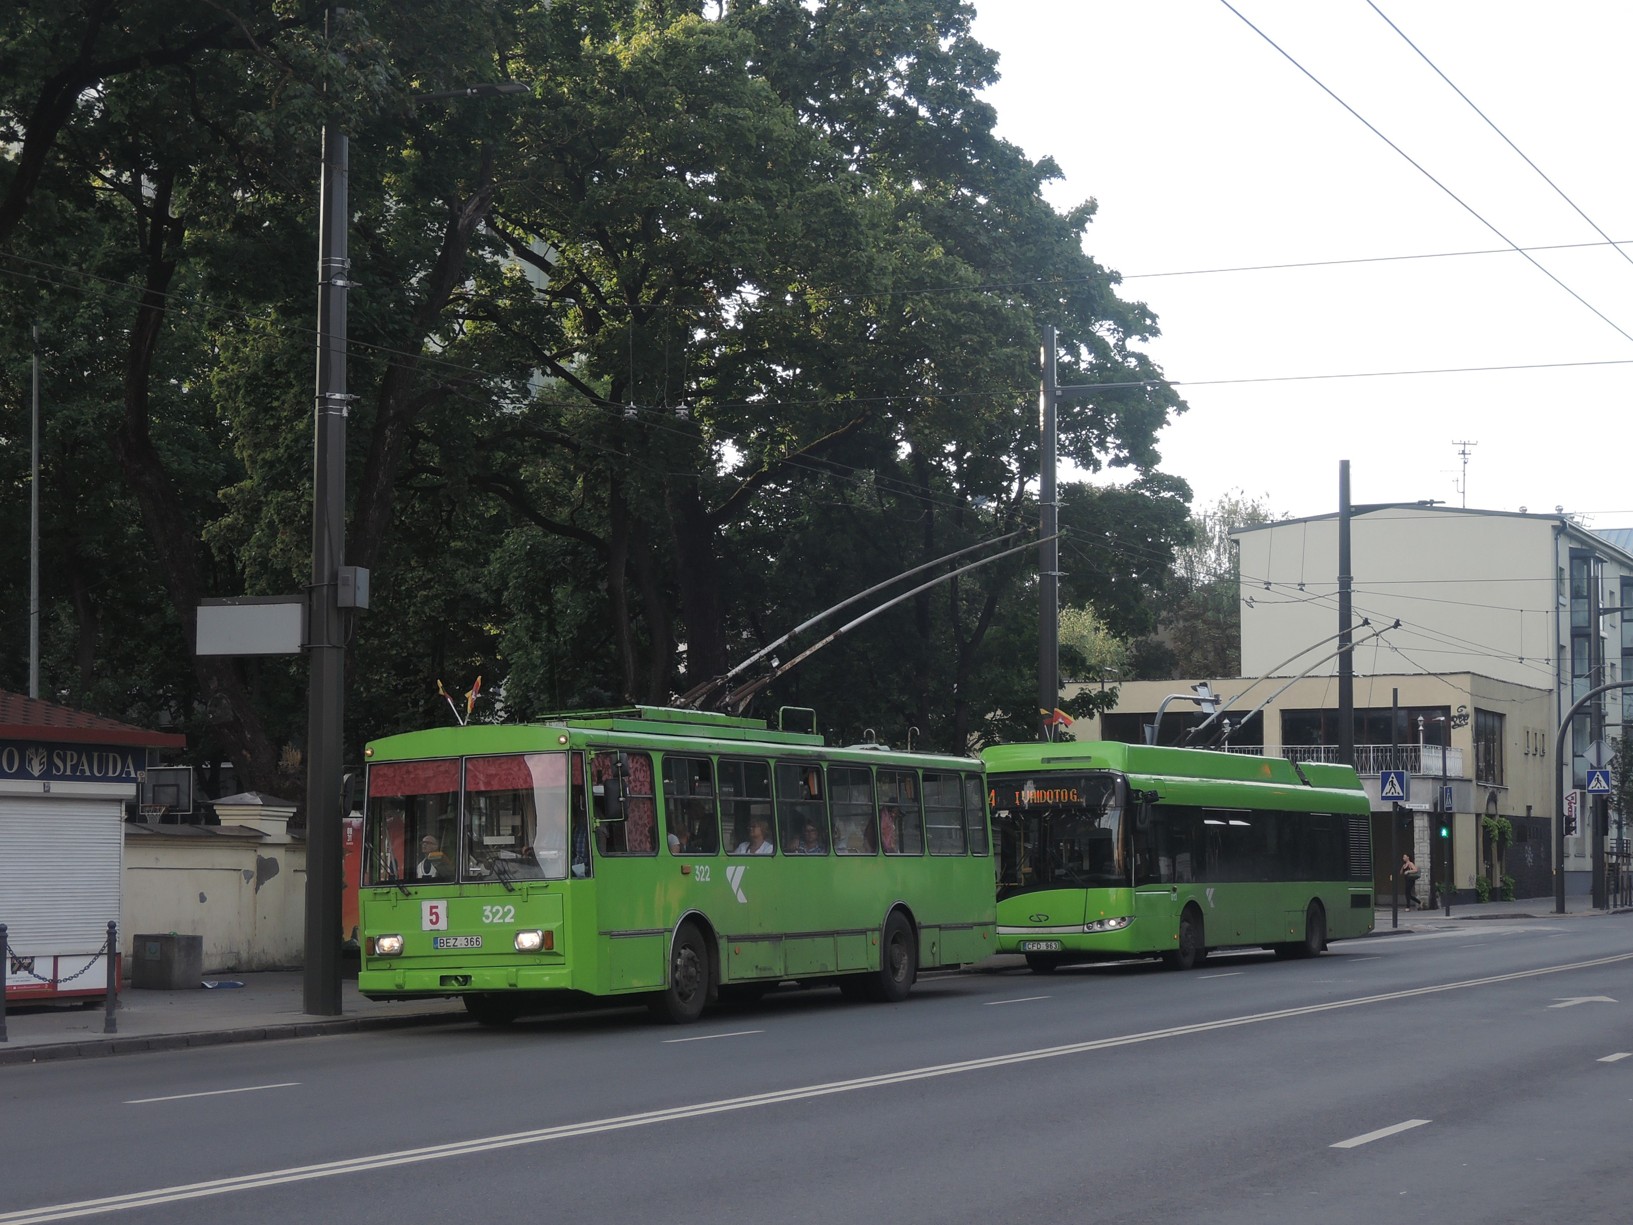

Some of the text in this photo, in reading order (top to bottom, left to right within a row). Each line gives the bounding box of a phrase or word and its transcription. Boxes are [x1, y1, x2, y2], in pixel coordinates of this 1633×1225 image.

[52, 749, 137, 778] SPAUDA
[694, 865, 711, 882] 322
[428, 905, 440, 926] 5
[482, 905, 515, 924] 322
[439, 937, 481, 948] BEZ 366
